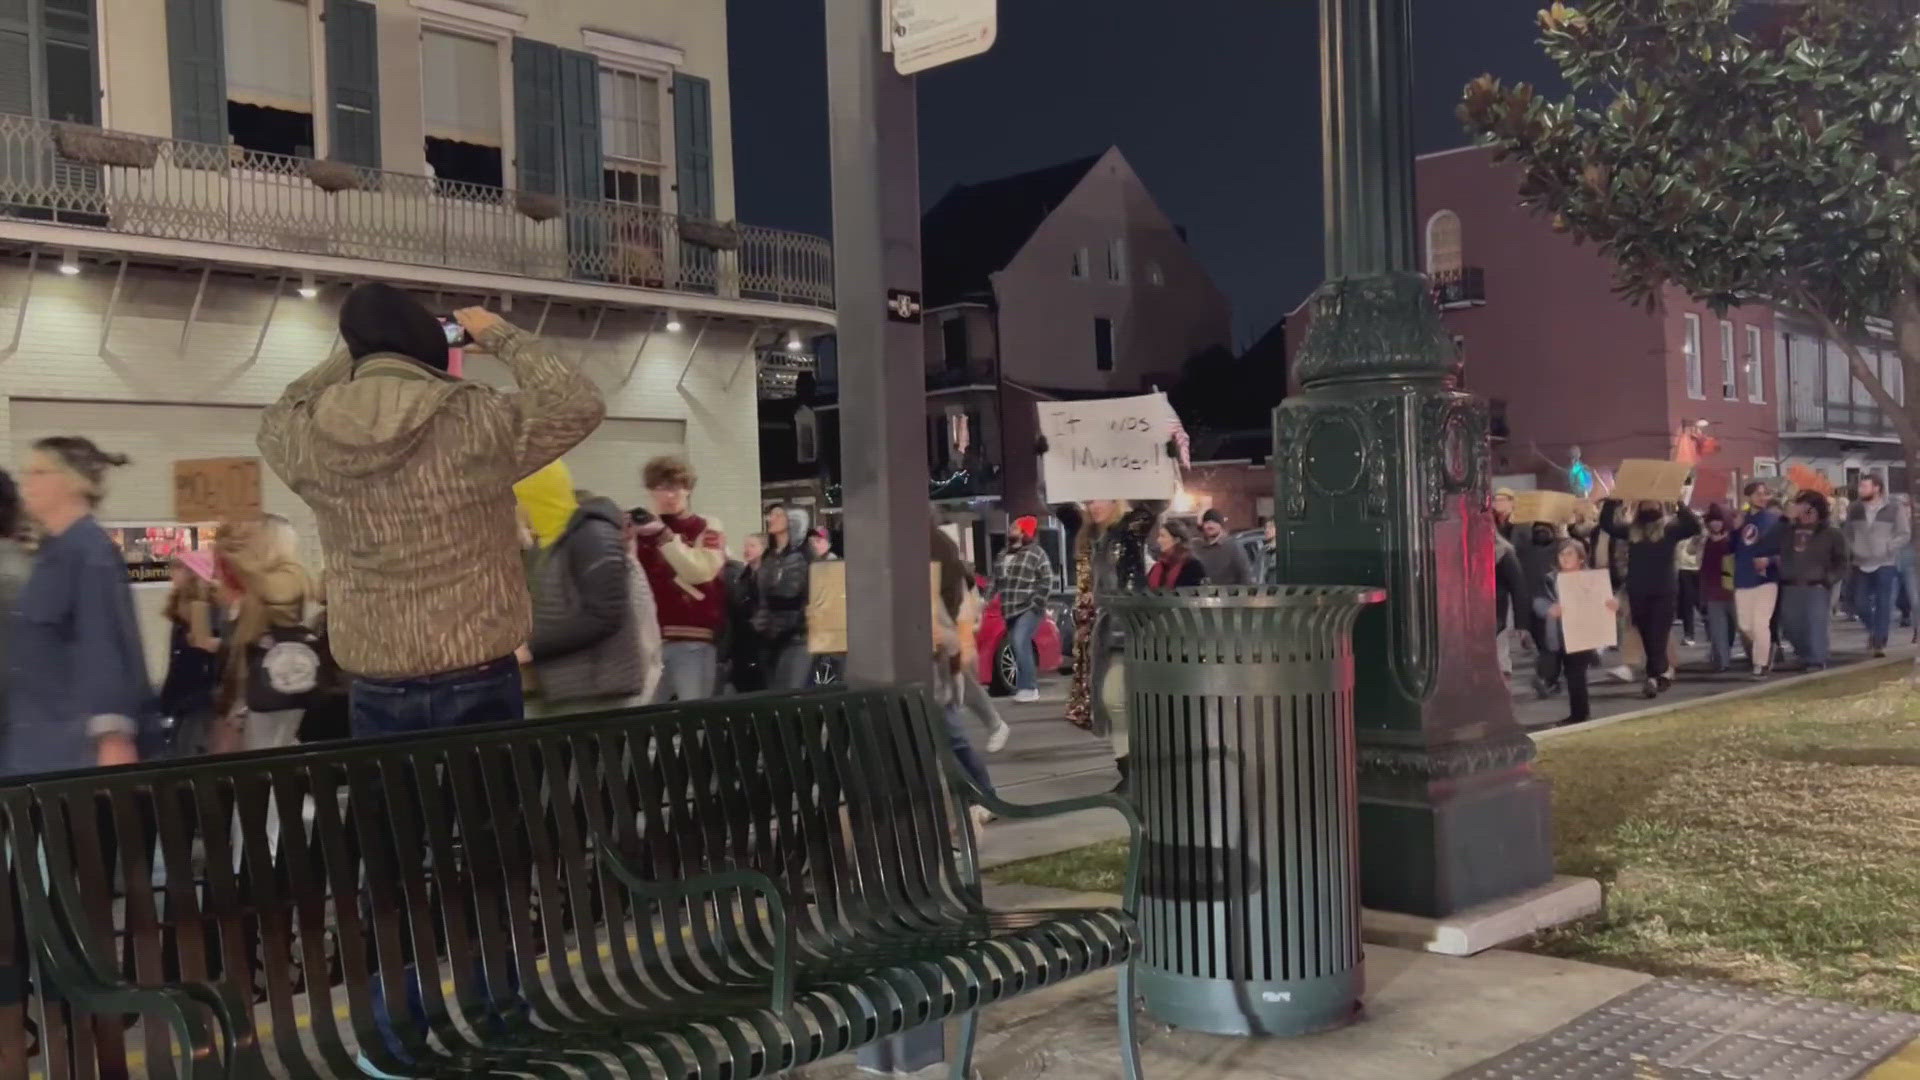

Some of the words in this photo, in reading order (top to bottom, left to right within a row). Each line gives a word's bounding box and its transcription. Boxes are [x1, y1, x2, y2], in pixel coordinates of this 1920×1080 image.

[1051, 411, 1081, 436] It
[1105, 416, 1151, 433] was
[1071, 442, 1160, 474] Murder!
